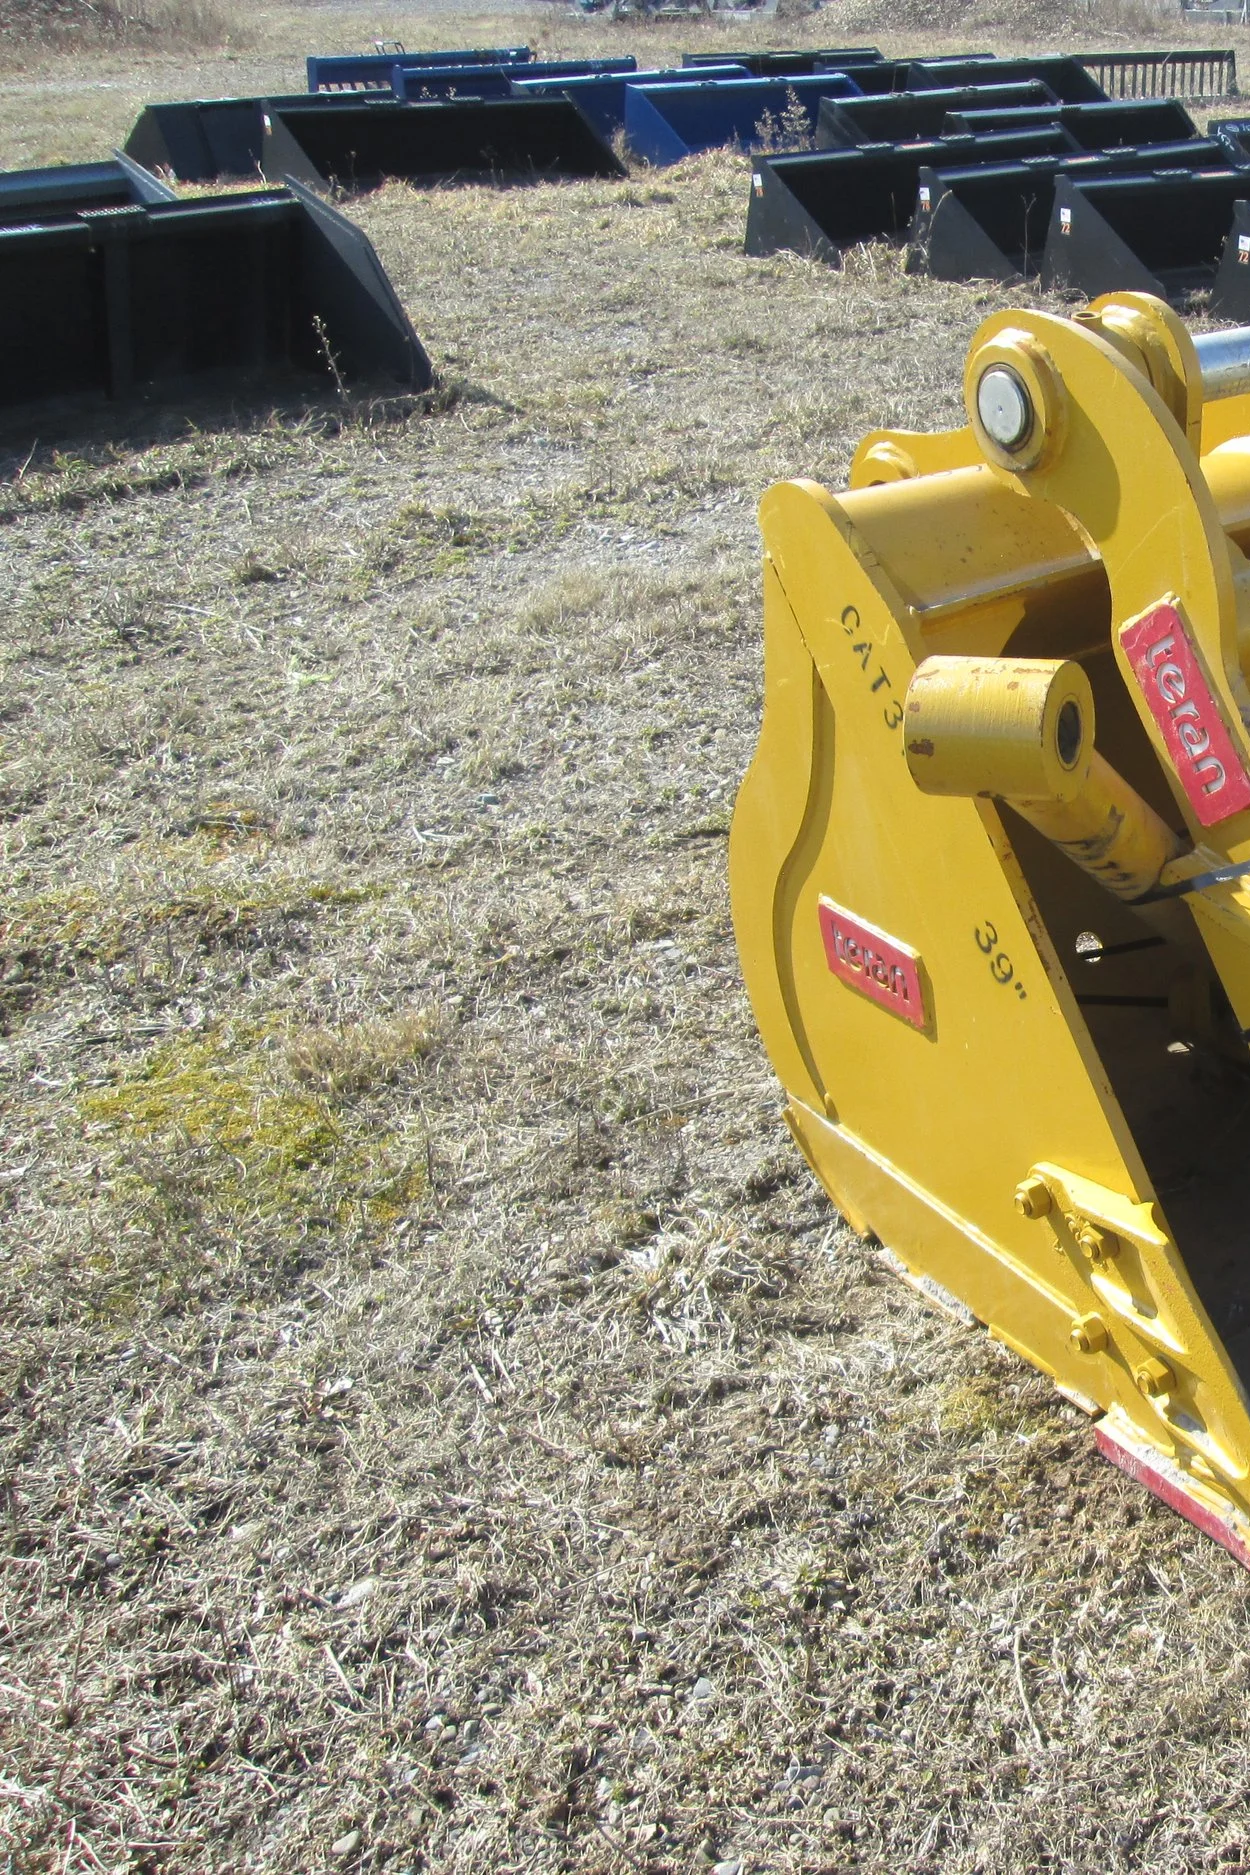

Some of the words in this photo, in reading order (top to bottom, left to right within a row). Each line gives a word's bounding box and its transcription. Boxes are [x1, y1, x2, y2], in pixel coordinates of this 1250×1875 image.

[841, 605, 904, 756] CAT3
[1145, 635, 1227, 796] teran
[832, 920, 910, 1003] teran
[975, 920, 1028, 1000] 39"
